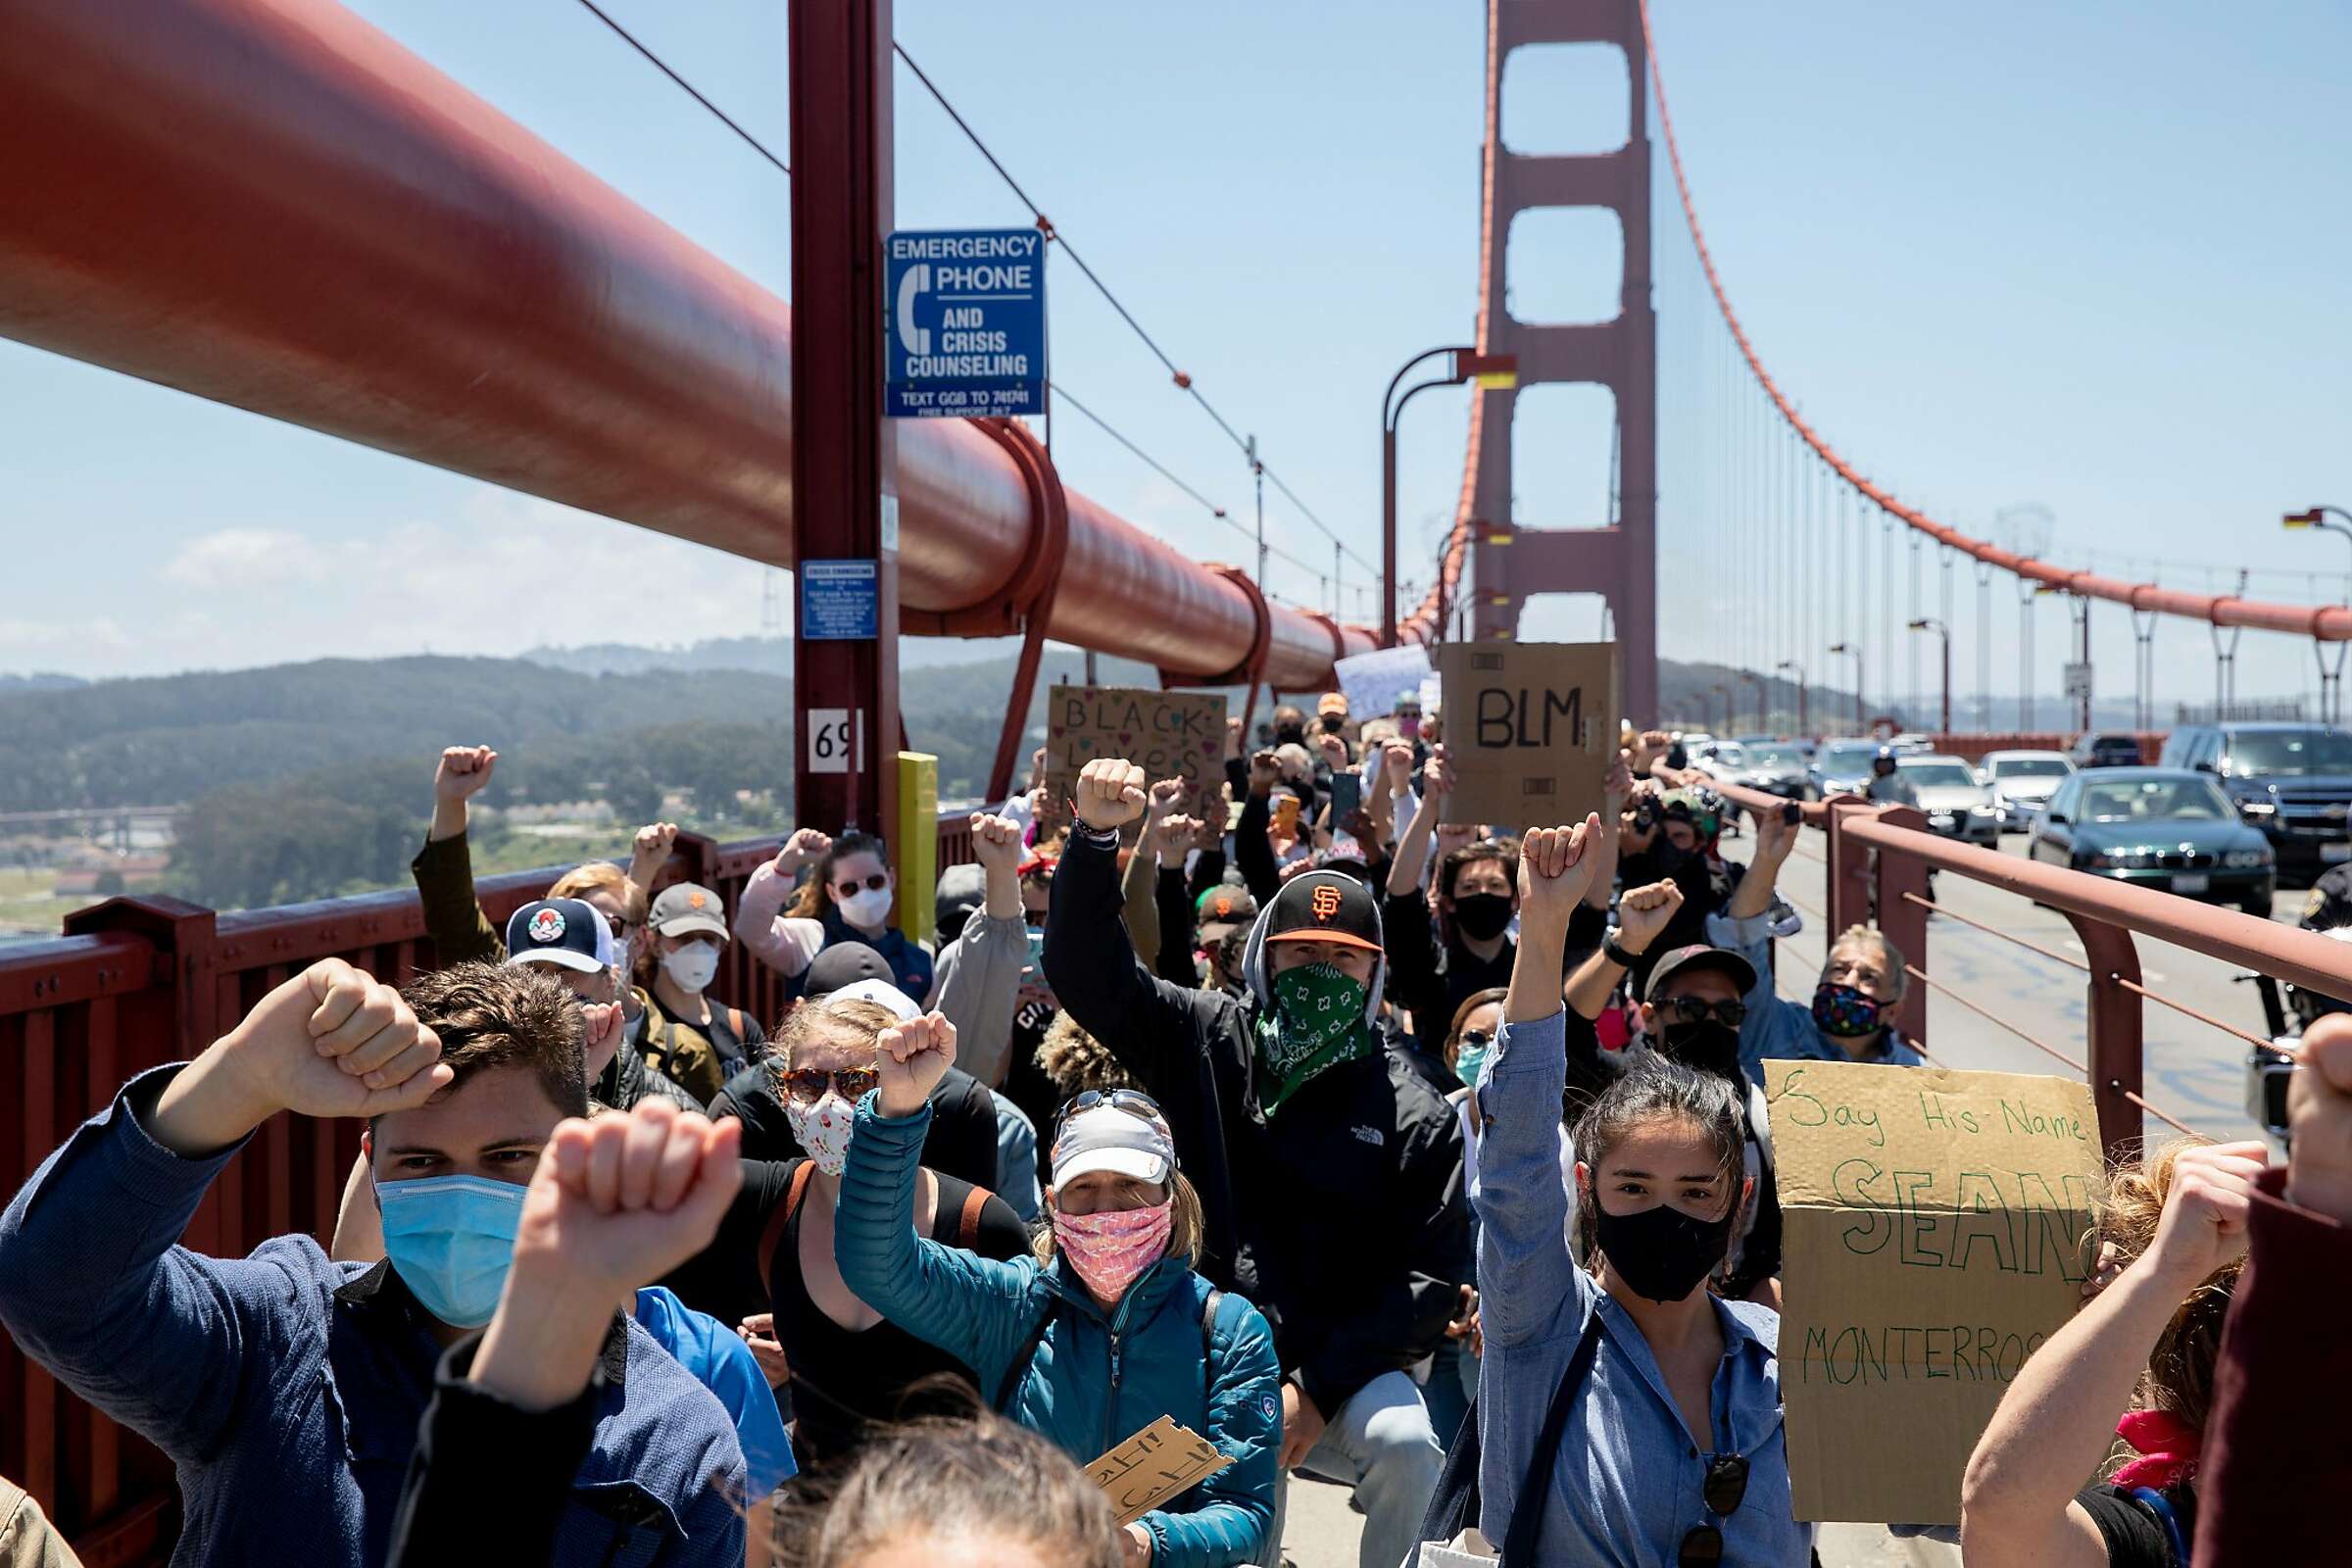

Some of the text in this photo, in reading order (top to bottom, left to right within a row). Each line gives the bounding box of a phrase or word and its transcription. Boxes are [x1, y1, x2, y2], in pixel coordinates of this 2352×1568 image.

[893, 236, 1037, 260] EMERGENCY
[937, 266, 1032, 291] PHONE
[943, 308, 983, 329] AND
[942, 331, 1007, 353] CRISIS
[906, 355, 1027, 378] COUNSELING
[901, 391, 935, 406] TEXT
[970, 390, 990, 405] TO
[1066, 699, 1203, 735] BLACK
[1477, 687, 1581, 748] BLM
[1783, 1068, 2086, 1147] Say His Name
[1833, 1158, 2095, 1286] SEAN
